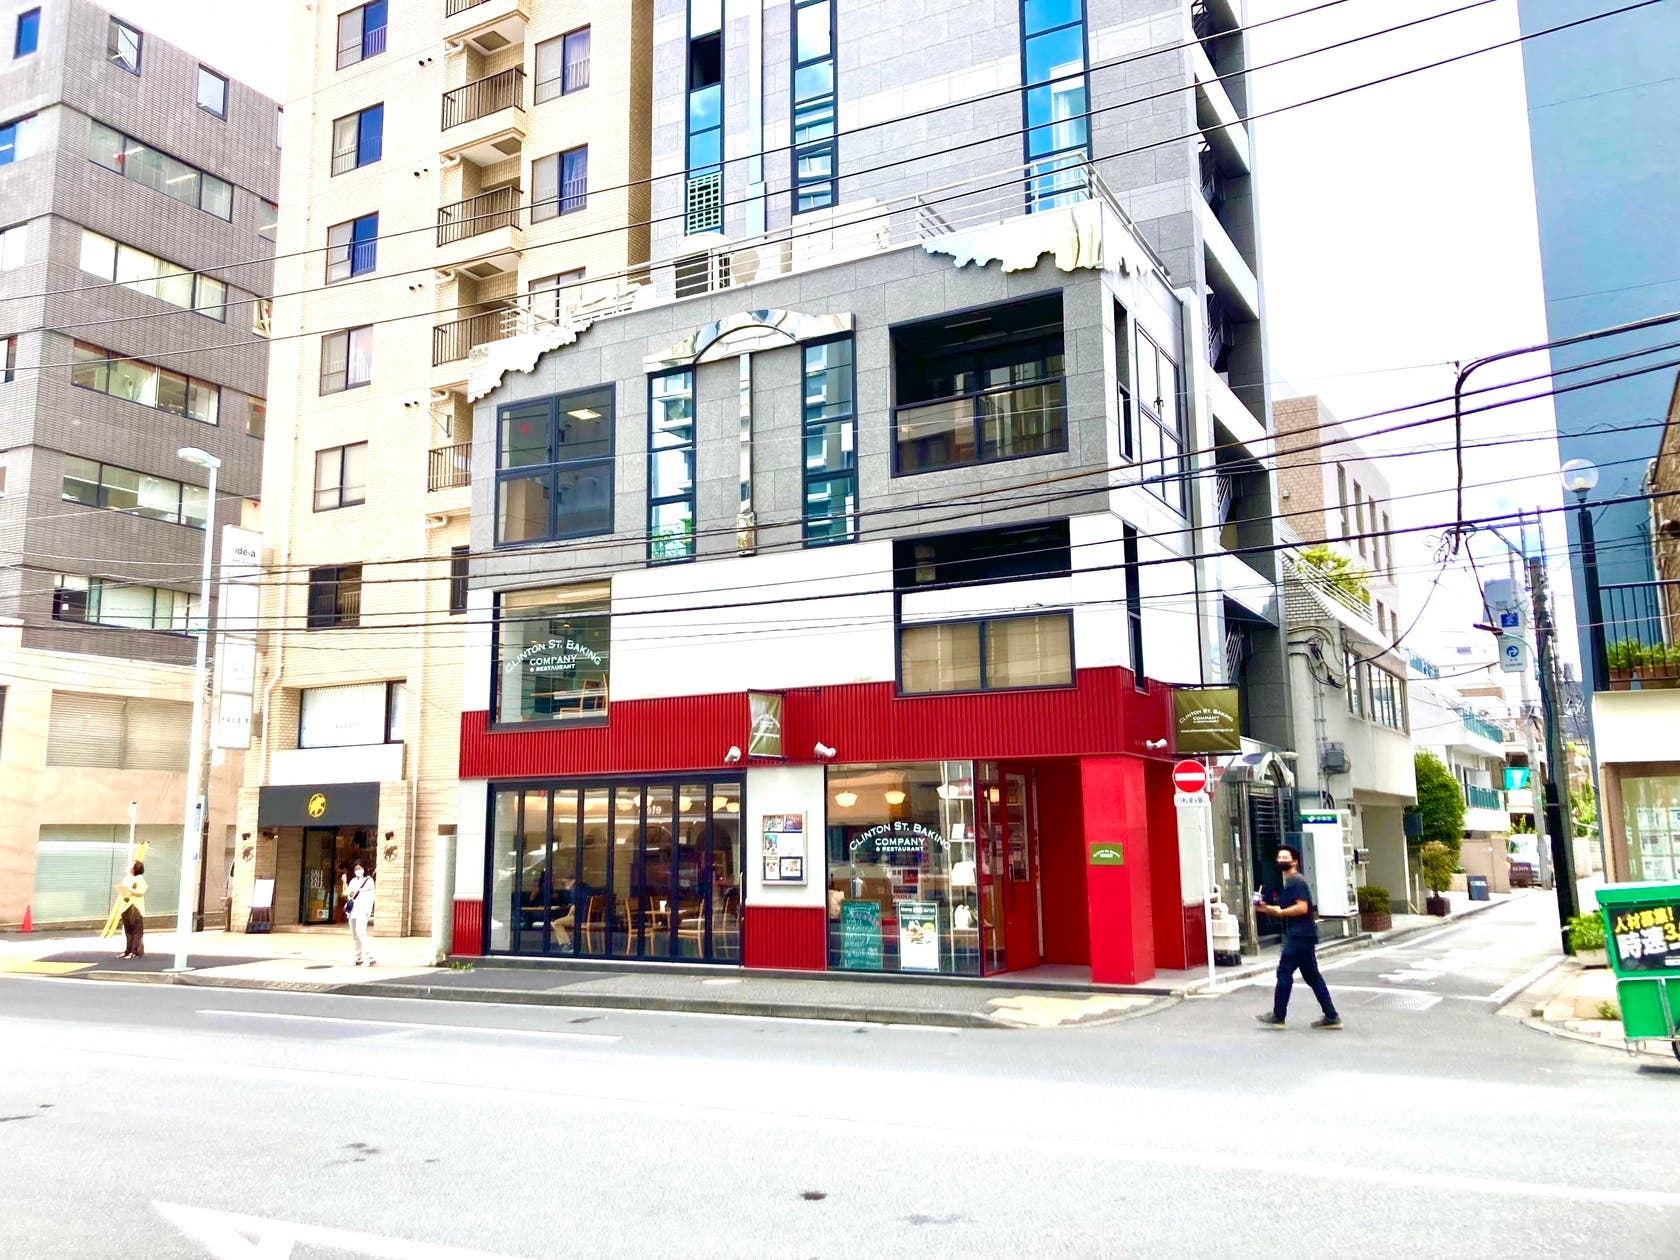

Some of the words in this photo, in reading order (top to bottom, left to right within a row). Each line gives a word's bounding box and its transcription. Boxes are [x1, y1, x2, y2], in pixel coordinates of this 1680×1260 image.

[504, 643, 546, 673] CLINTON
[548, 639, 563, 649] ST.
[566, 639, 602, 666] BAKING
[529, 654, 577, 666] COMPANY
[535, 663, 576, 672] RESTAURANT
[849, 823, 891, 851] CLINTON
[894, 821, 910, 831] ST.
[913, 823, 952, 851] BAKING
[874, 837, 925, 846] COMPANY
